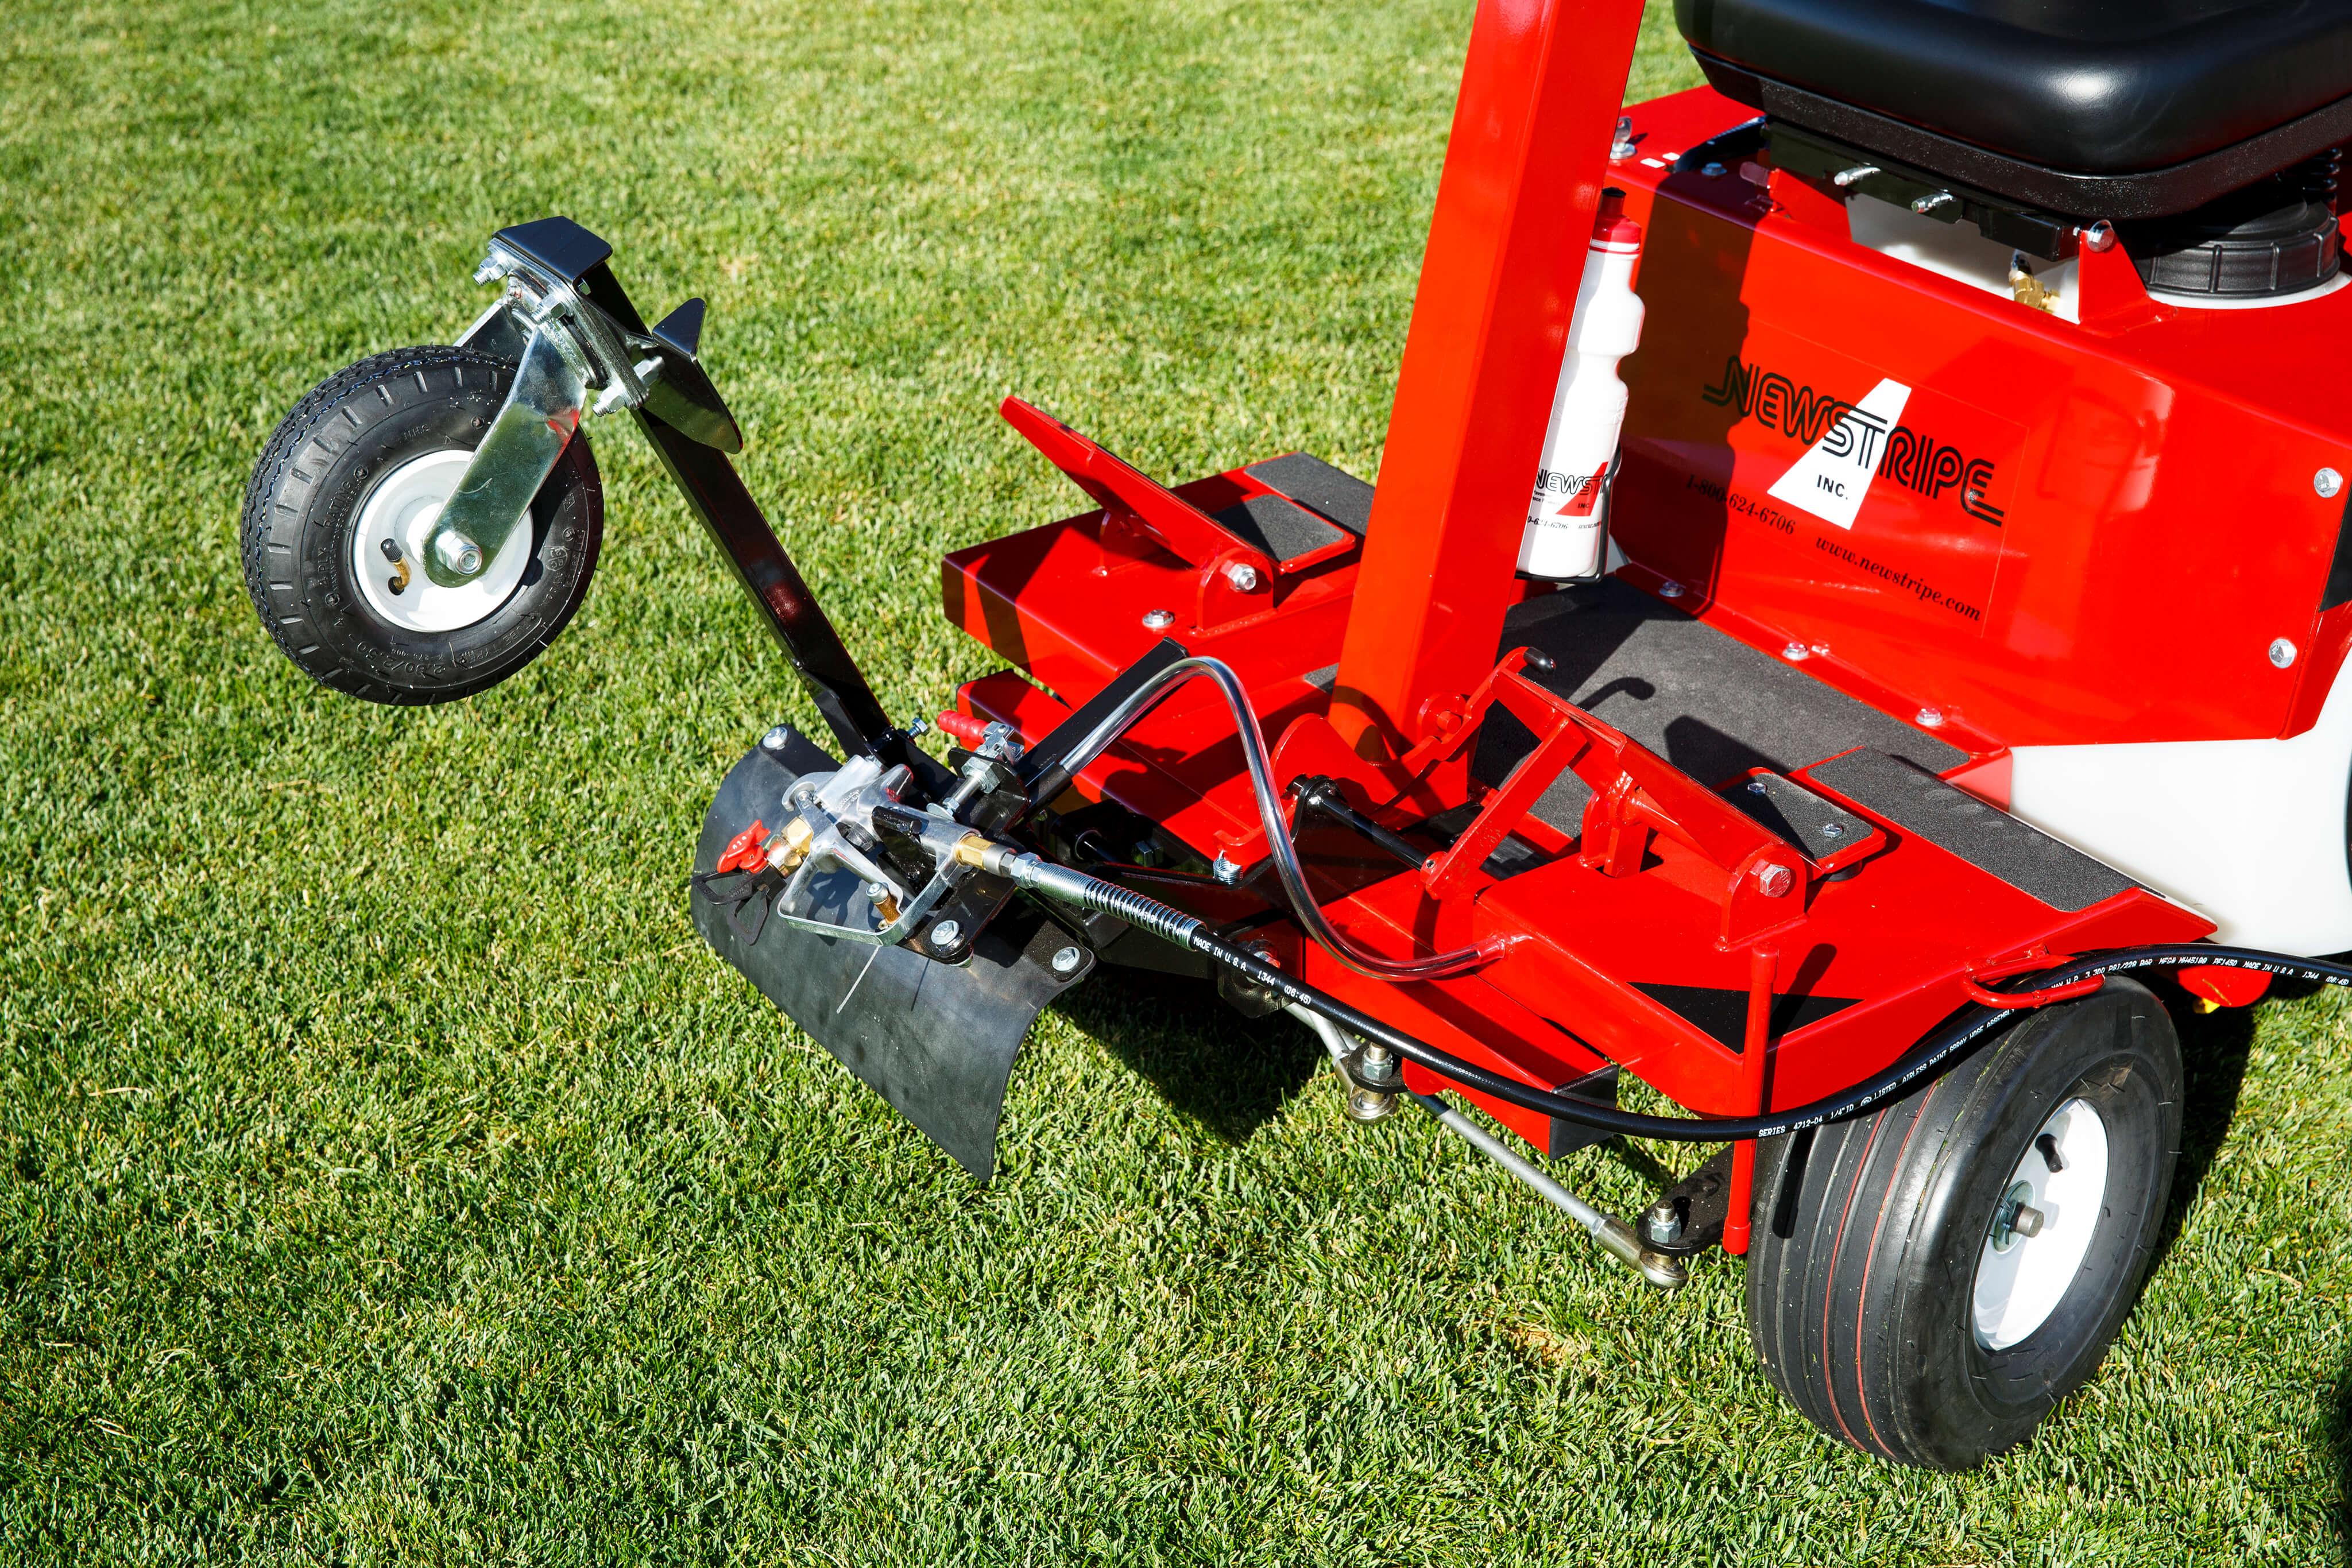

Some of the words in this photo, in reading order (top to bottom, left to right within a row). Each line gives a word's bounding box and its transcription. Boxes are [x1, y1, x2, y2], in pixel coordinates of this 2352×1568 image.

[1702, 355, 2004, 526] NEWSTRIPE
[324, 479, 352, 527] RATING
[1817, 474, 1848, 500] INC.
[1686, 474, 1796, 535] 1-800-624-6706
[1816, 536, 1981, 621] www.newstripe.com
[504, 623, 530, 645] TUBE
[1193, 936, 1211, 952] MADE
[1213, 946, 1222, 957] IN
[1257, 970, 1275, 986] 1344
[2139, 958, 2153, 967] BAR
[2242, 960, 2261, 969] MADE
[2262, 963, 2272, 971] IN
[2302, 971, 2320, 979] 1344
[1758, 1125, 1786, 1138] SERIES
[1793, 1116, 1823, 1130] 4712-04
[1874, 1082, 1897, 1099] LISTED
[1902, 1063, 1927, 1083] AIRLESS
[1929, 1050, 1947, 1066] PAINT
